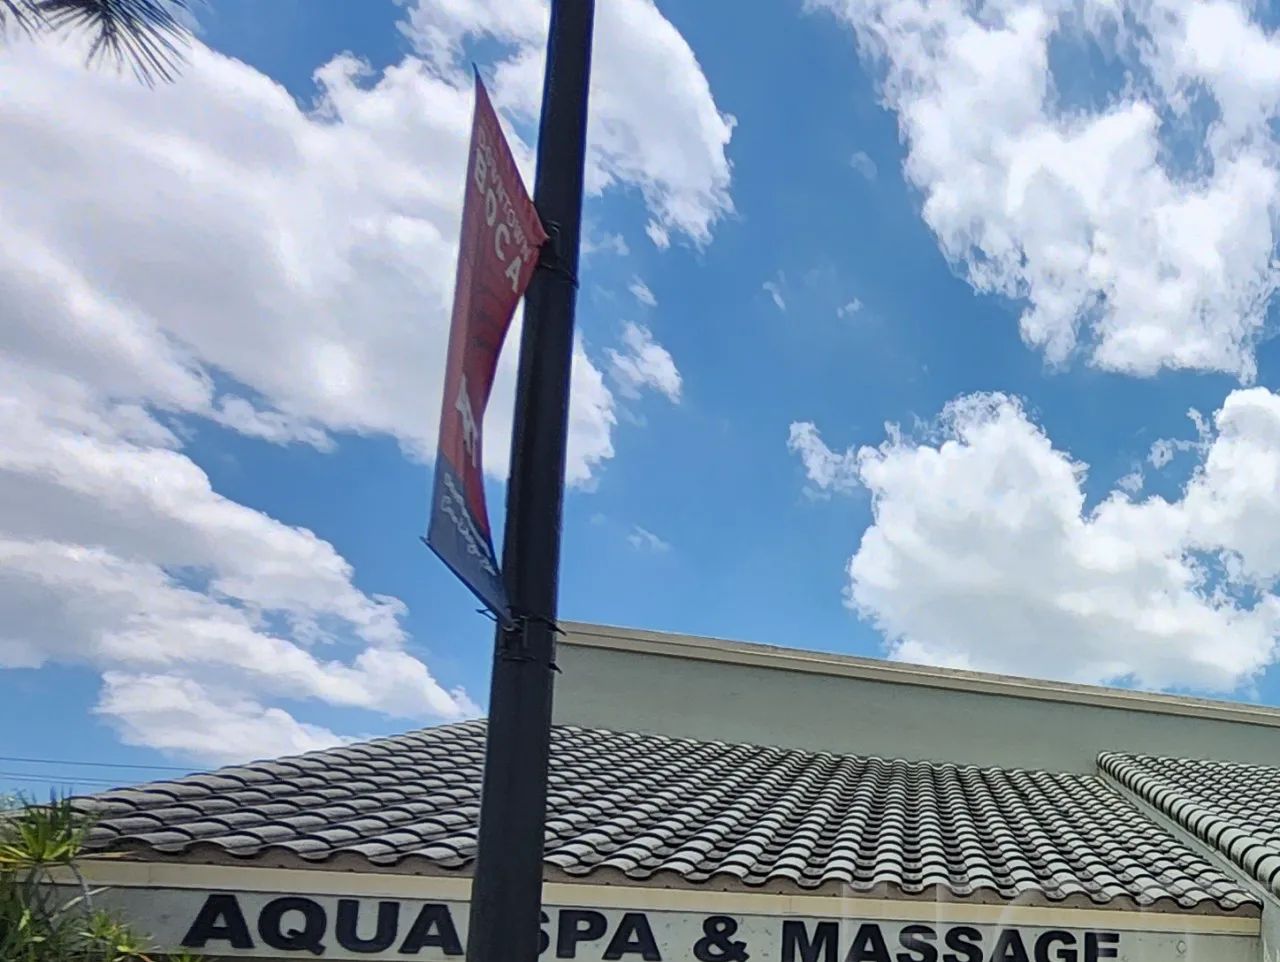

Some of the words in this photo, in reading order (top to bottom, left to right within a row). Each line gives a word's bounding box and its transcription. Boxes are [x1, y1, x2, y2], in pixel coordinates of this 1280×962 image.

[474, 149, 522, 293] BOCA
[180, 894, 464, 956] AQUA
[536, 909, 662, 962] PA
